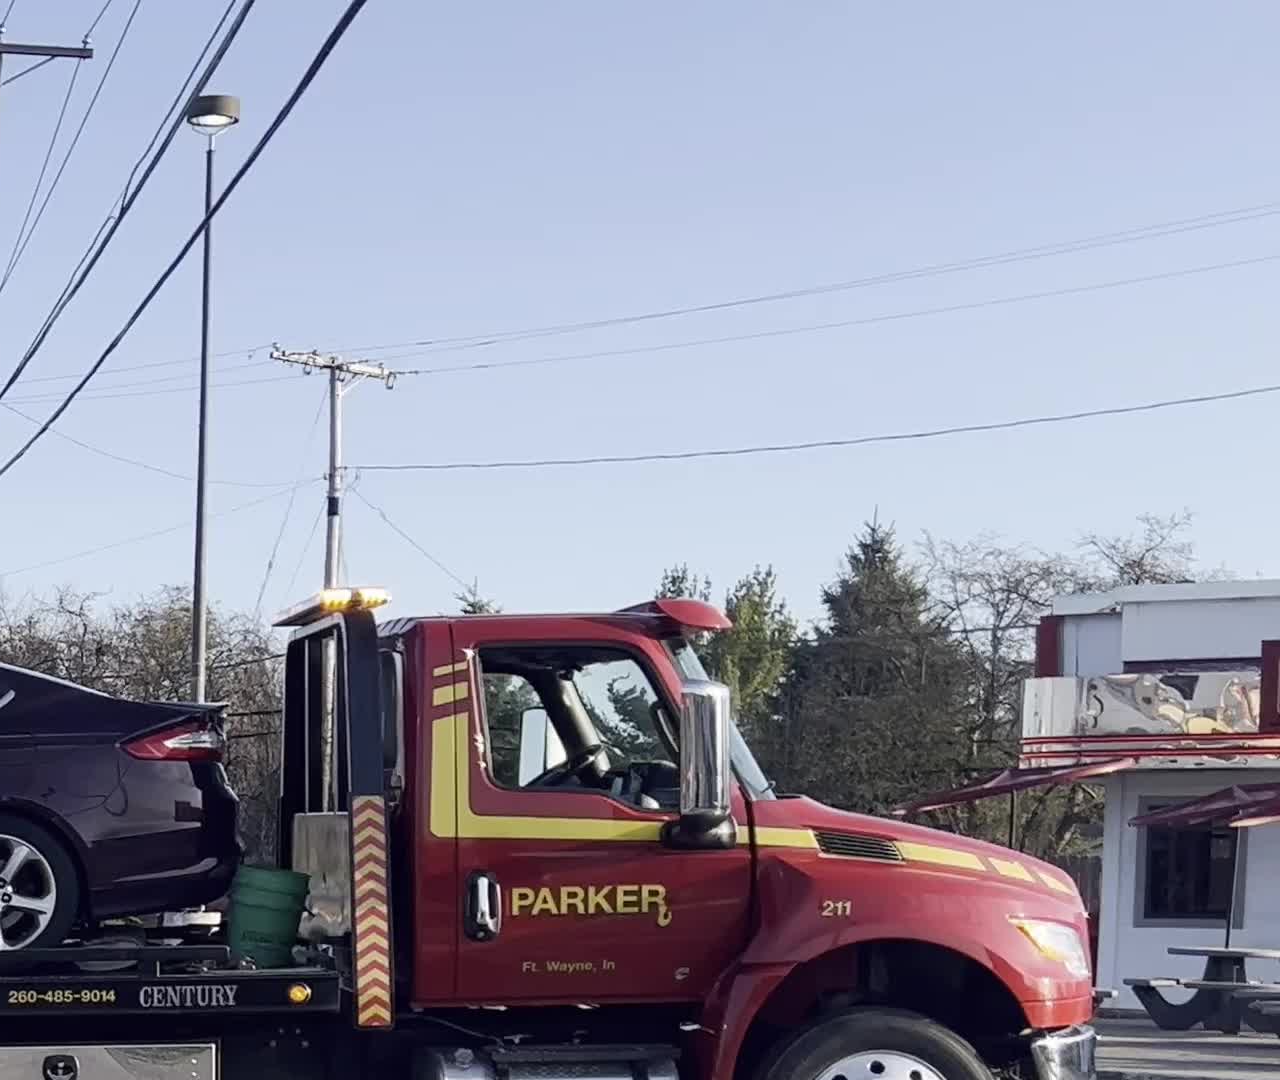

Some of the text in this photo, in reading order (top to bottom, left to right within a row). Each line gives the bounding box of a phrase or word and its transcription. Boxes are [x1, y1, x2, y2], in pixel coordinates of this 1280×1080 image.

[511, 884, 672, 927] PARKER
[821, 900, 852, 916] 211
[522, 959, 616, 974] Ft. Wayne, In
[8, 985, 238, 1008] 260-485-9014 CENTURY
